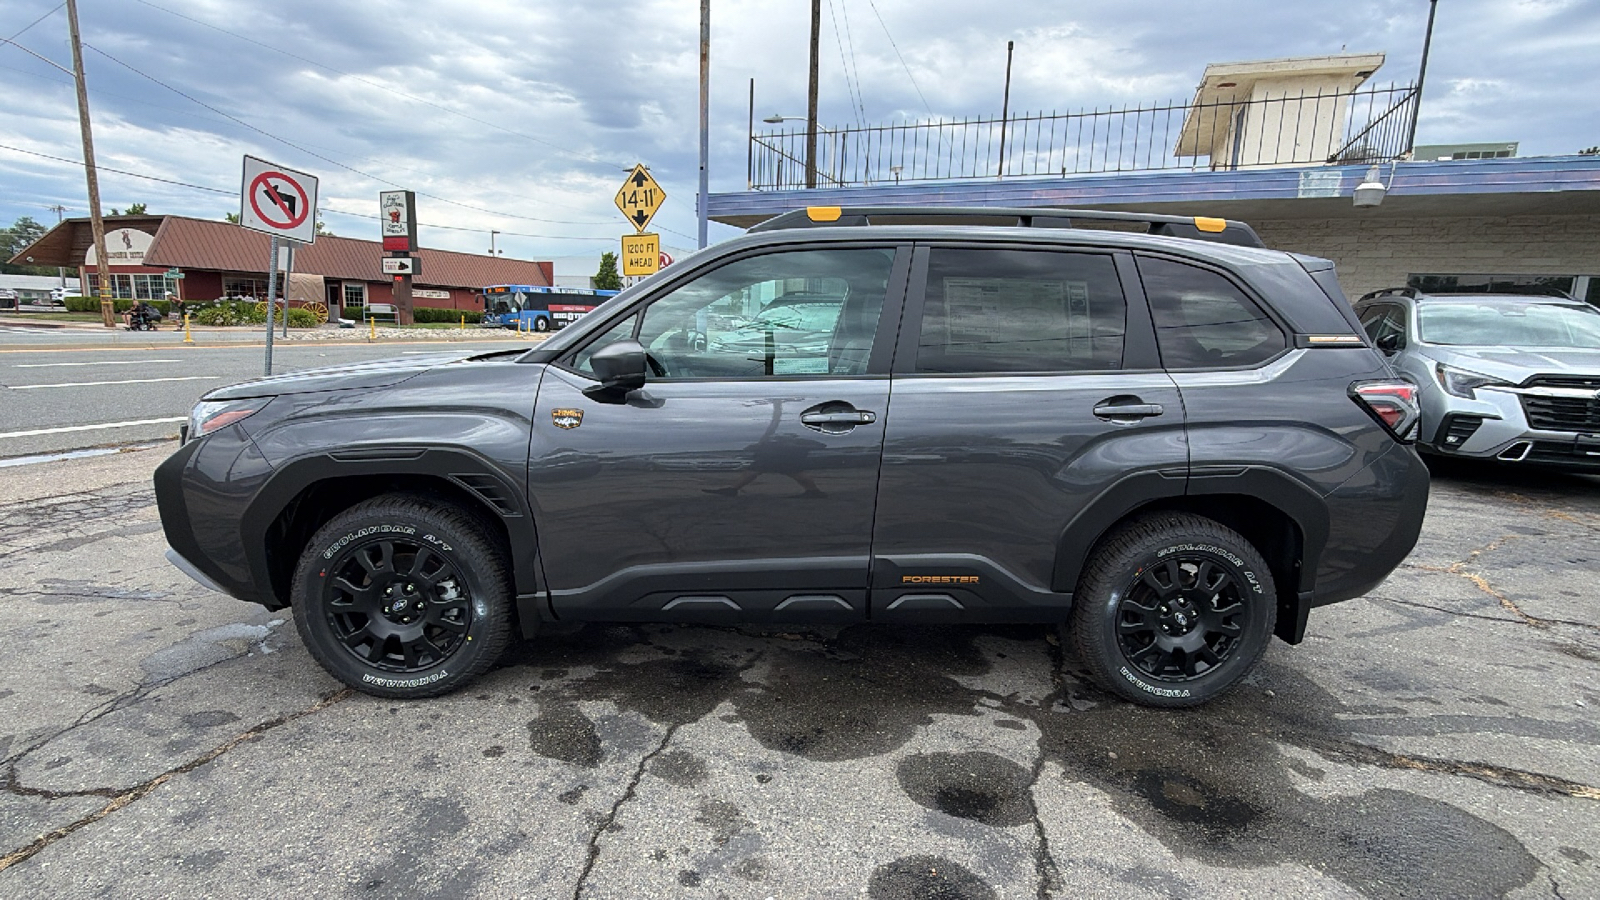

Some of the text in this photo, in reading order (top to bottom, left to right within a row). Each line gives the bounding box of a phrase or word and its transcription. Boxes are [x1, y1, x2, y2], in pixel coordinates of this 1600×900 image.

[627, 243, 655, 254] 1200 FT
[629, 258, 653, 268] AHEAD
[323, 525, 453, 560] GEOLANDAR A/T
[902, 575, 979, 583] FORESTER
[362, 669, 448, 688] YOKOHAMA
